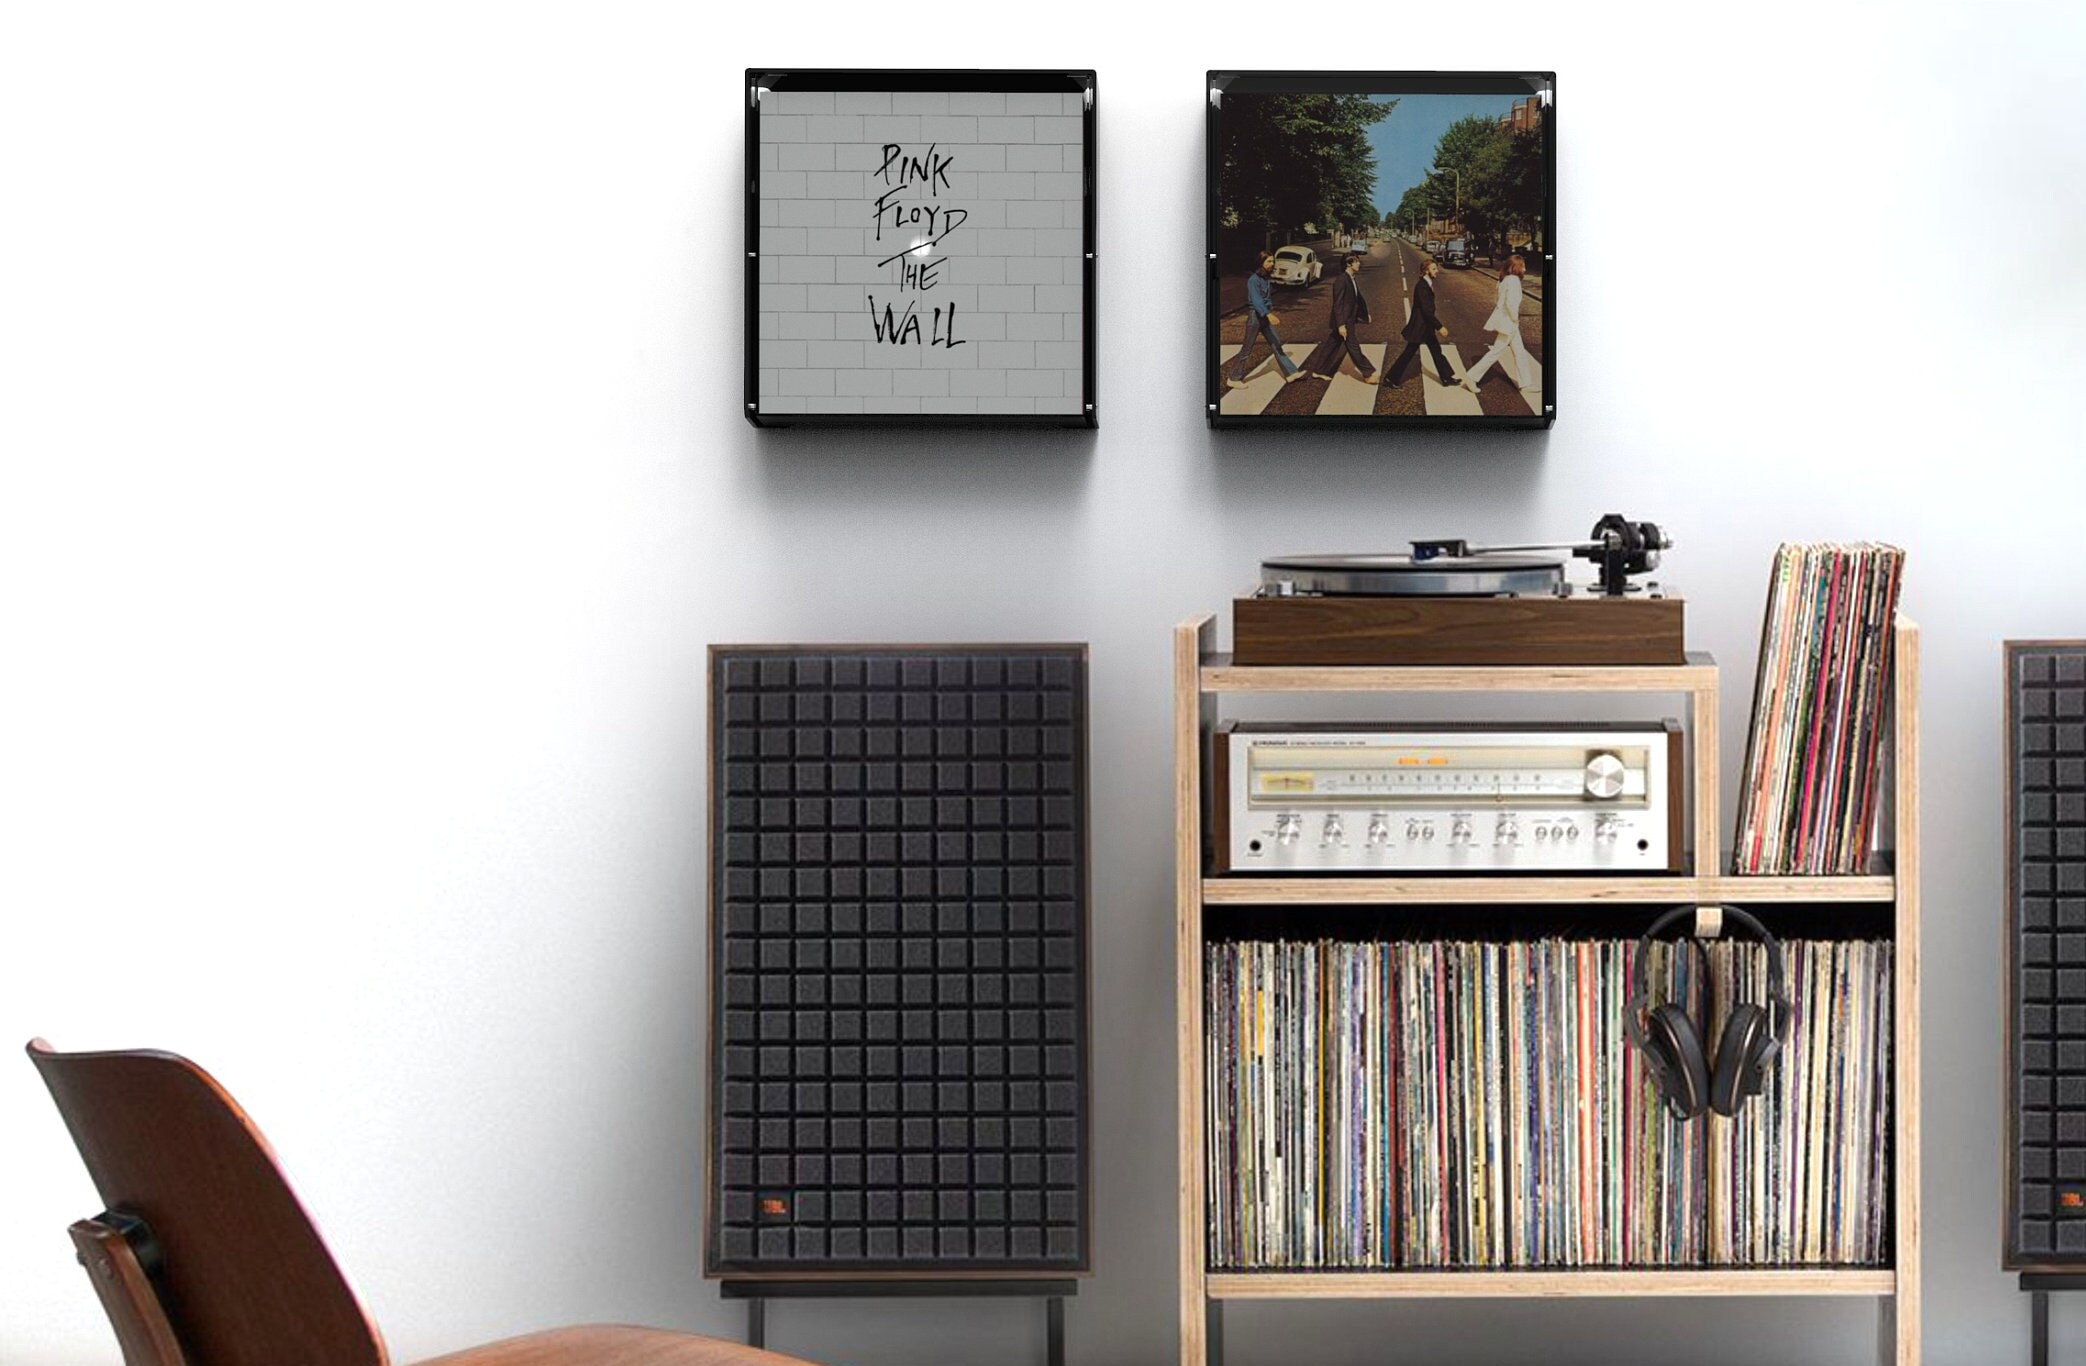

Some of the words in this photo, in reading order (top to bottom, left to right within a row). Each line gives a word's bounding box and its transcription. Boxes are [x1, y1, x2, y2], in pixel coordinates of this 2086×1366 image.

[873, 143, 954, 197] PINK
[873, 185, 968, 247] FLOYD
[877, 240, 948, 293] THE
[868, 295, 966, 349] WALL
